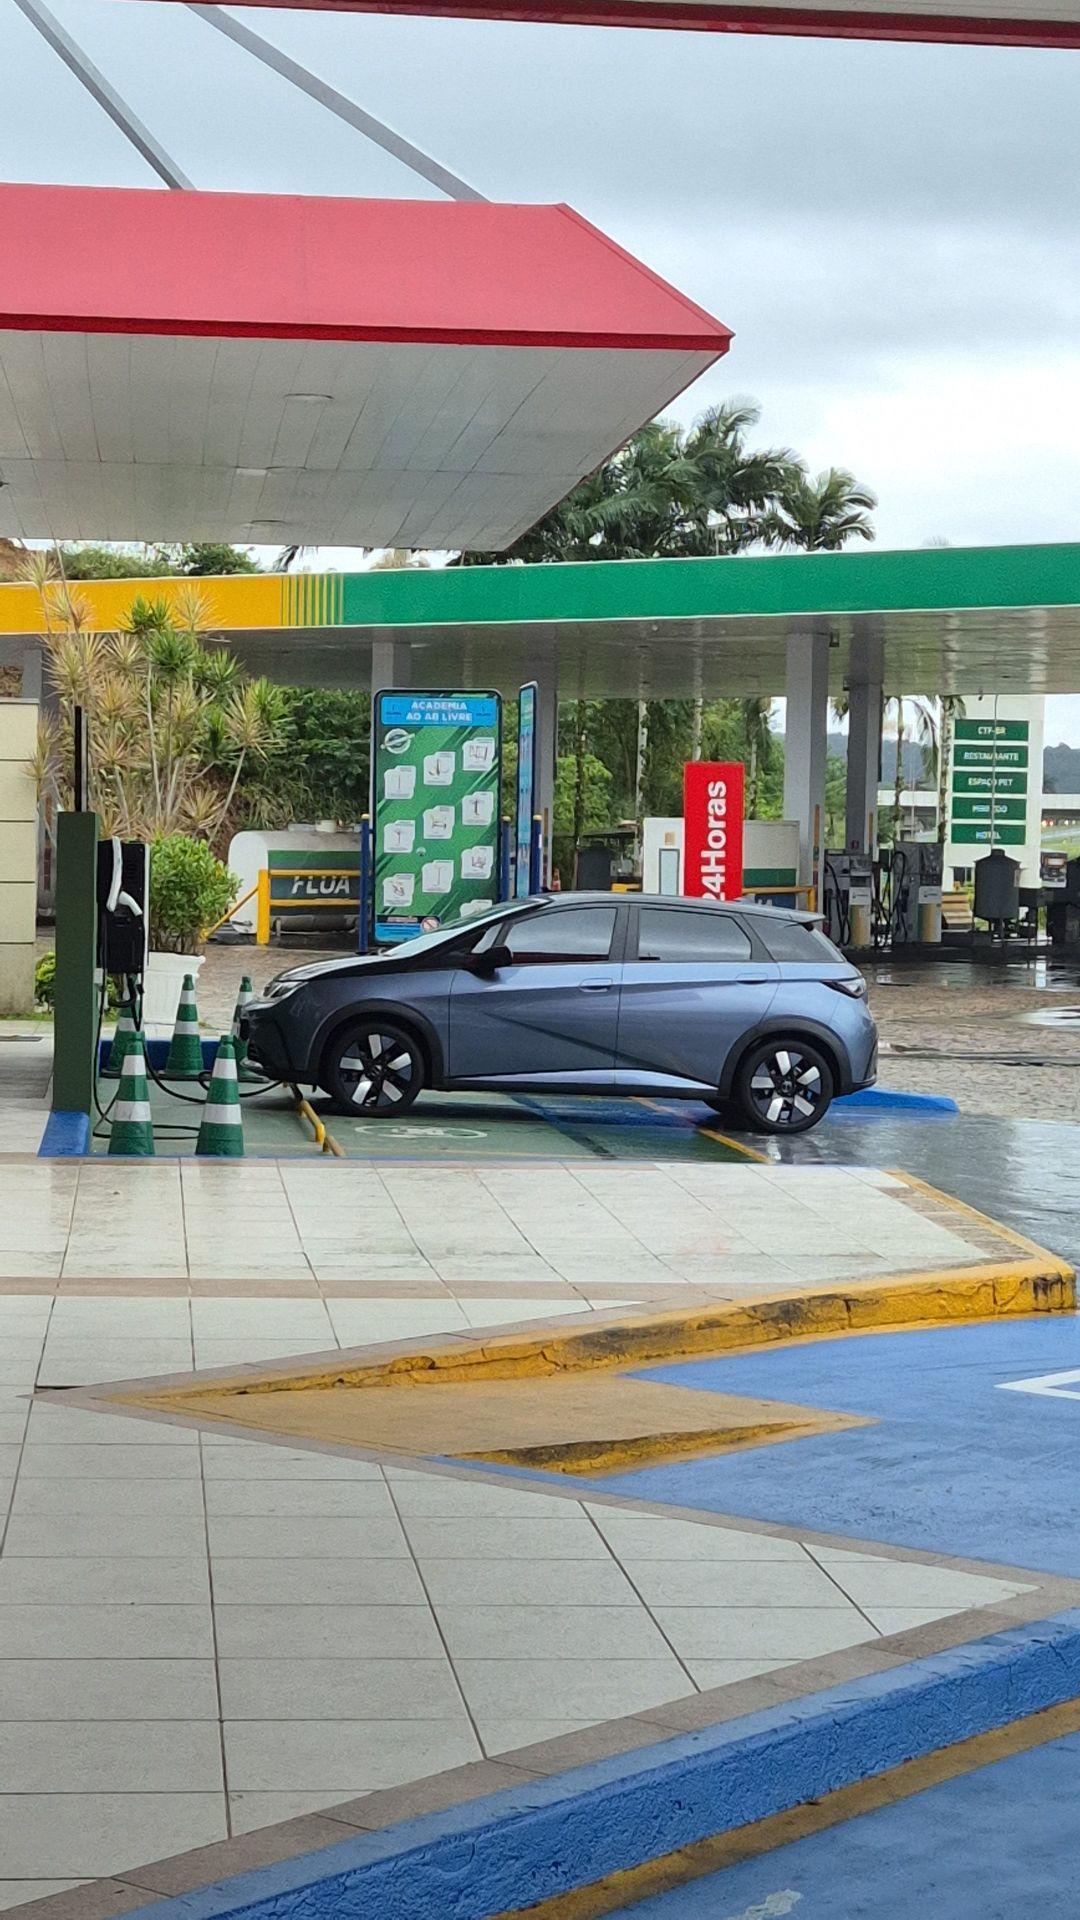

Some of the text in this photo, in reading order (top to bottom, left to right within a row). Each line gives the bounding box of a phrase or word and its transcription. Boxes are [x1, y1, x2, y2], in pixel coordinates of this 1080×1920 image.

[411, 701, 468, 711] ACADEMIA
[405, 713, 421, 721] AO
[441, 713, 473, 722] LIVRE
[998, 778, 1013, 787] PET
[291, 875, 350, 894] FLUA
